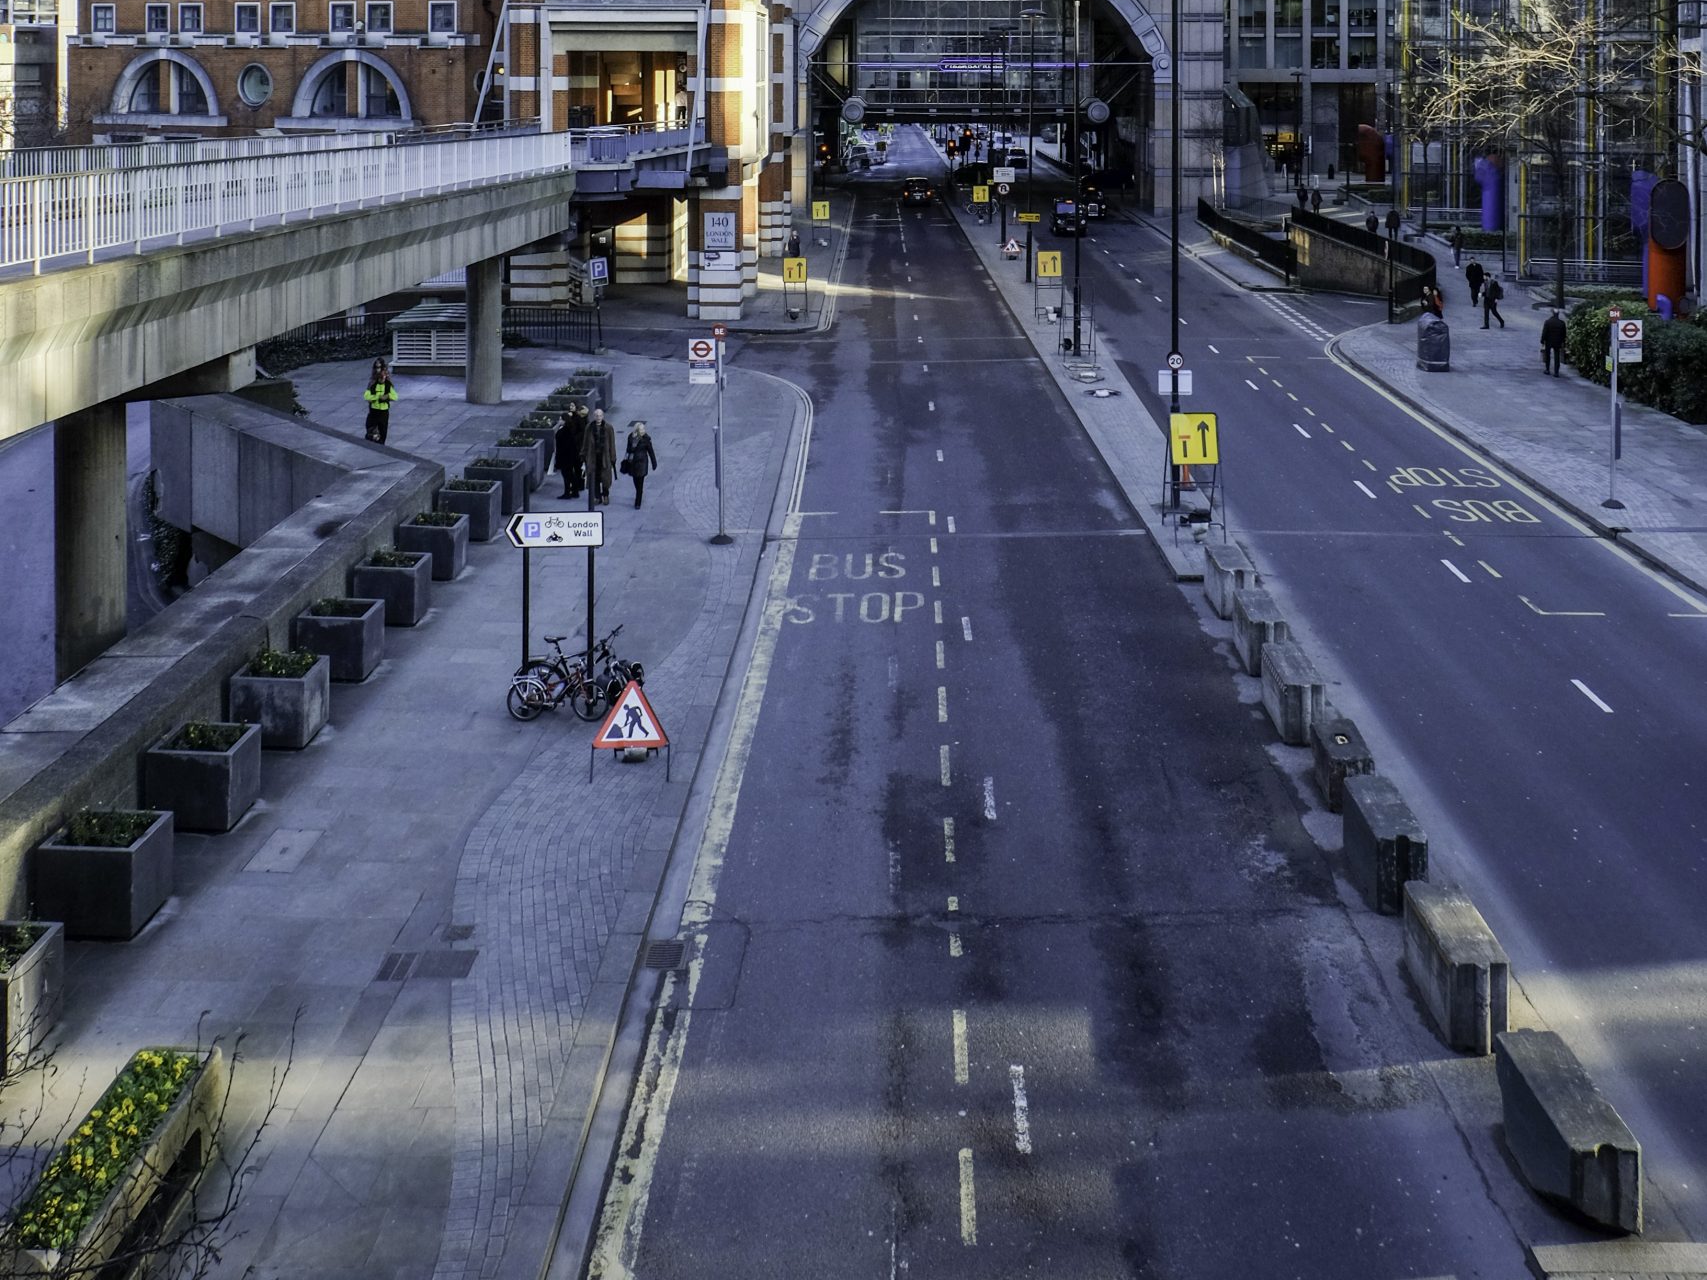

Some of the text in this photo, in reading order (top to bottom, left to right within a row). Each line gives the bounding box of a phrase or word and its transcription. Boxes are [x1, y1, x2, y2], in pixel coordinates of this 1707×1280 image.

[711, 217, 729, 228] 140
[594, 262, 603, 277] P
[1170, 357, 1182, 365] 20
[1389, 467, 1501, 488] STOP
[1431, 499, 1542, 523] BUS
[527, 521, 599, 537] P London
[573, 529, 593, 537] Wall
[808, 552, 906, 581] BUS
[785, 591, 925, 624] STOP
